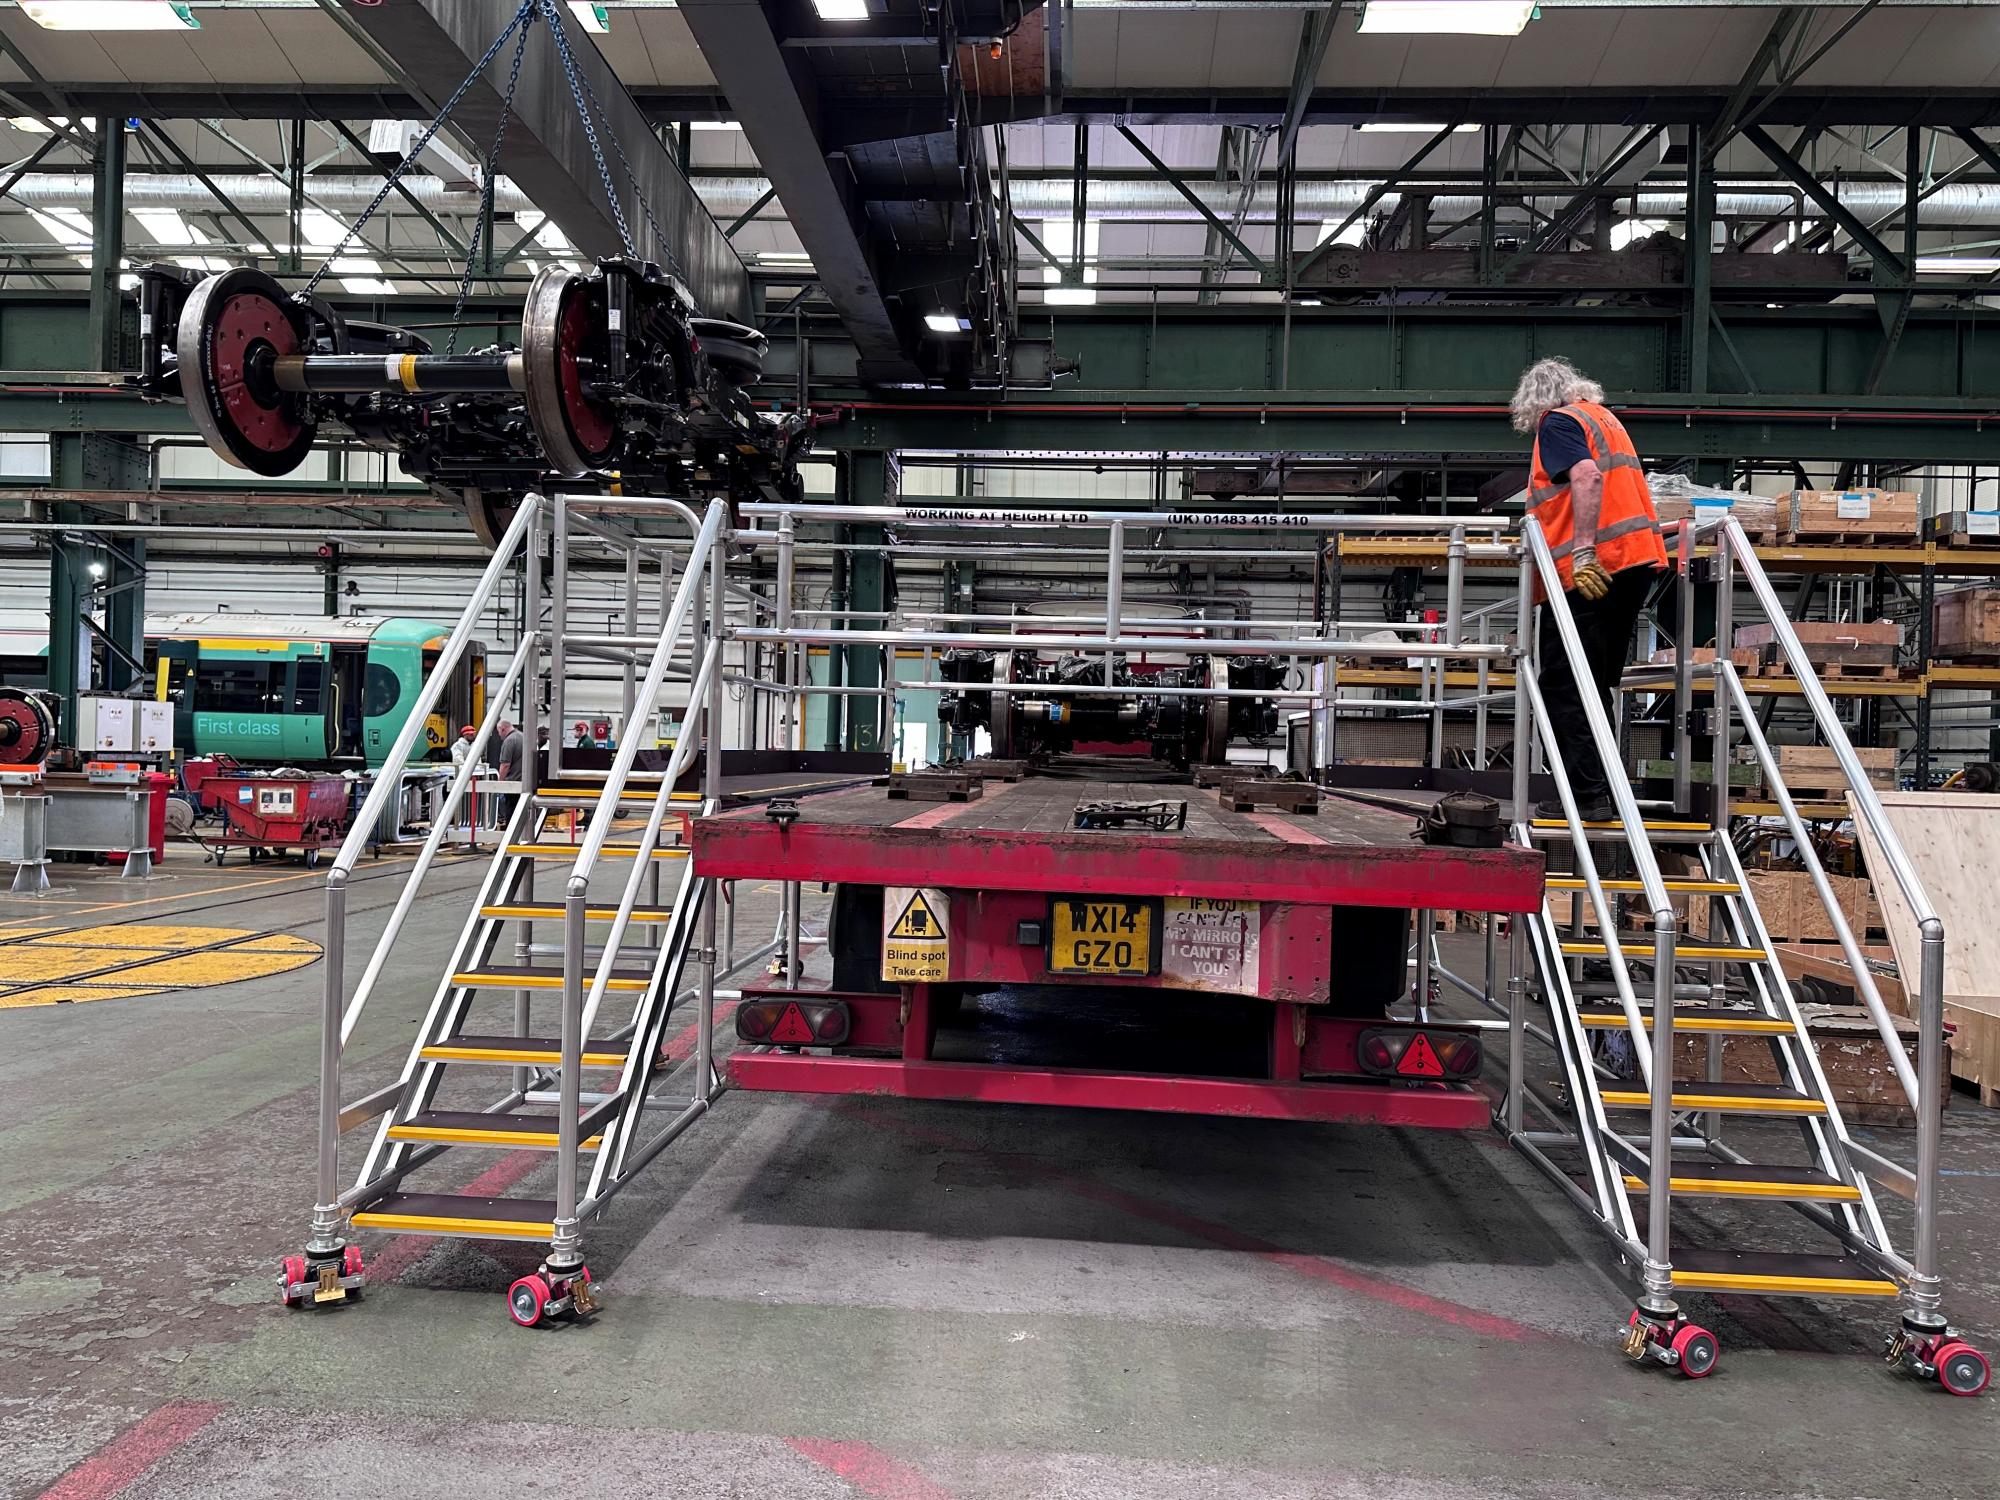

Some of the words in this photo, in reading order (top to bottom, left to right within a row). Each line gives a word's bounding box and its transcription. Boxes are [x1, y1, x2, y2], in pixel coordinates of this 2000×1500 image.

[905, 509, 975, 520] WORKING
[979, 512, 996, 521] AT
[1002, 511, 1056, 522] HEIGHT
[1062, 513, 1089, 523] LTD
[1167, 514, 1199, 525] (UK)
[1203, 514, 1247, 525] 01483
[1251, 515, 1278, 526] 415
[1282, 516, 1309, 526] 410
[197, 718, 233, 734] First
[238, 719, 280, 735] class
[853, 724, 873, 751] 13
[1190, 898, 1203, 910] IF
[1206, 899, 1236, 912] YOU
[1070, 905, 1137, 933] WX14
[1165, 926, 1189, 940] MY
[887, 949, 918, 960] Blind
[920, 950, 946, 963] spot
[1171, 943, 1176, 957] I
[1180, 944, 1223, 960] CAN'T
[892, 966, 916, 976] Take
[919, 968, 941, 977] care
